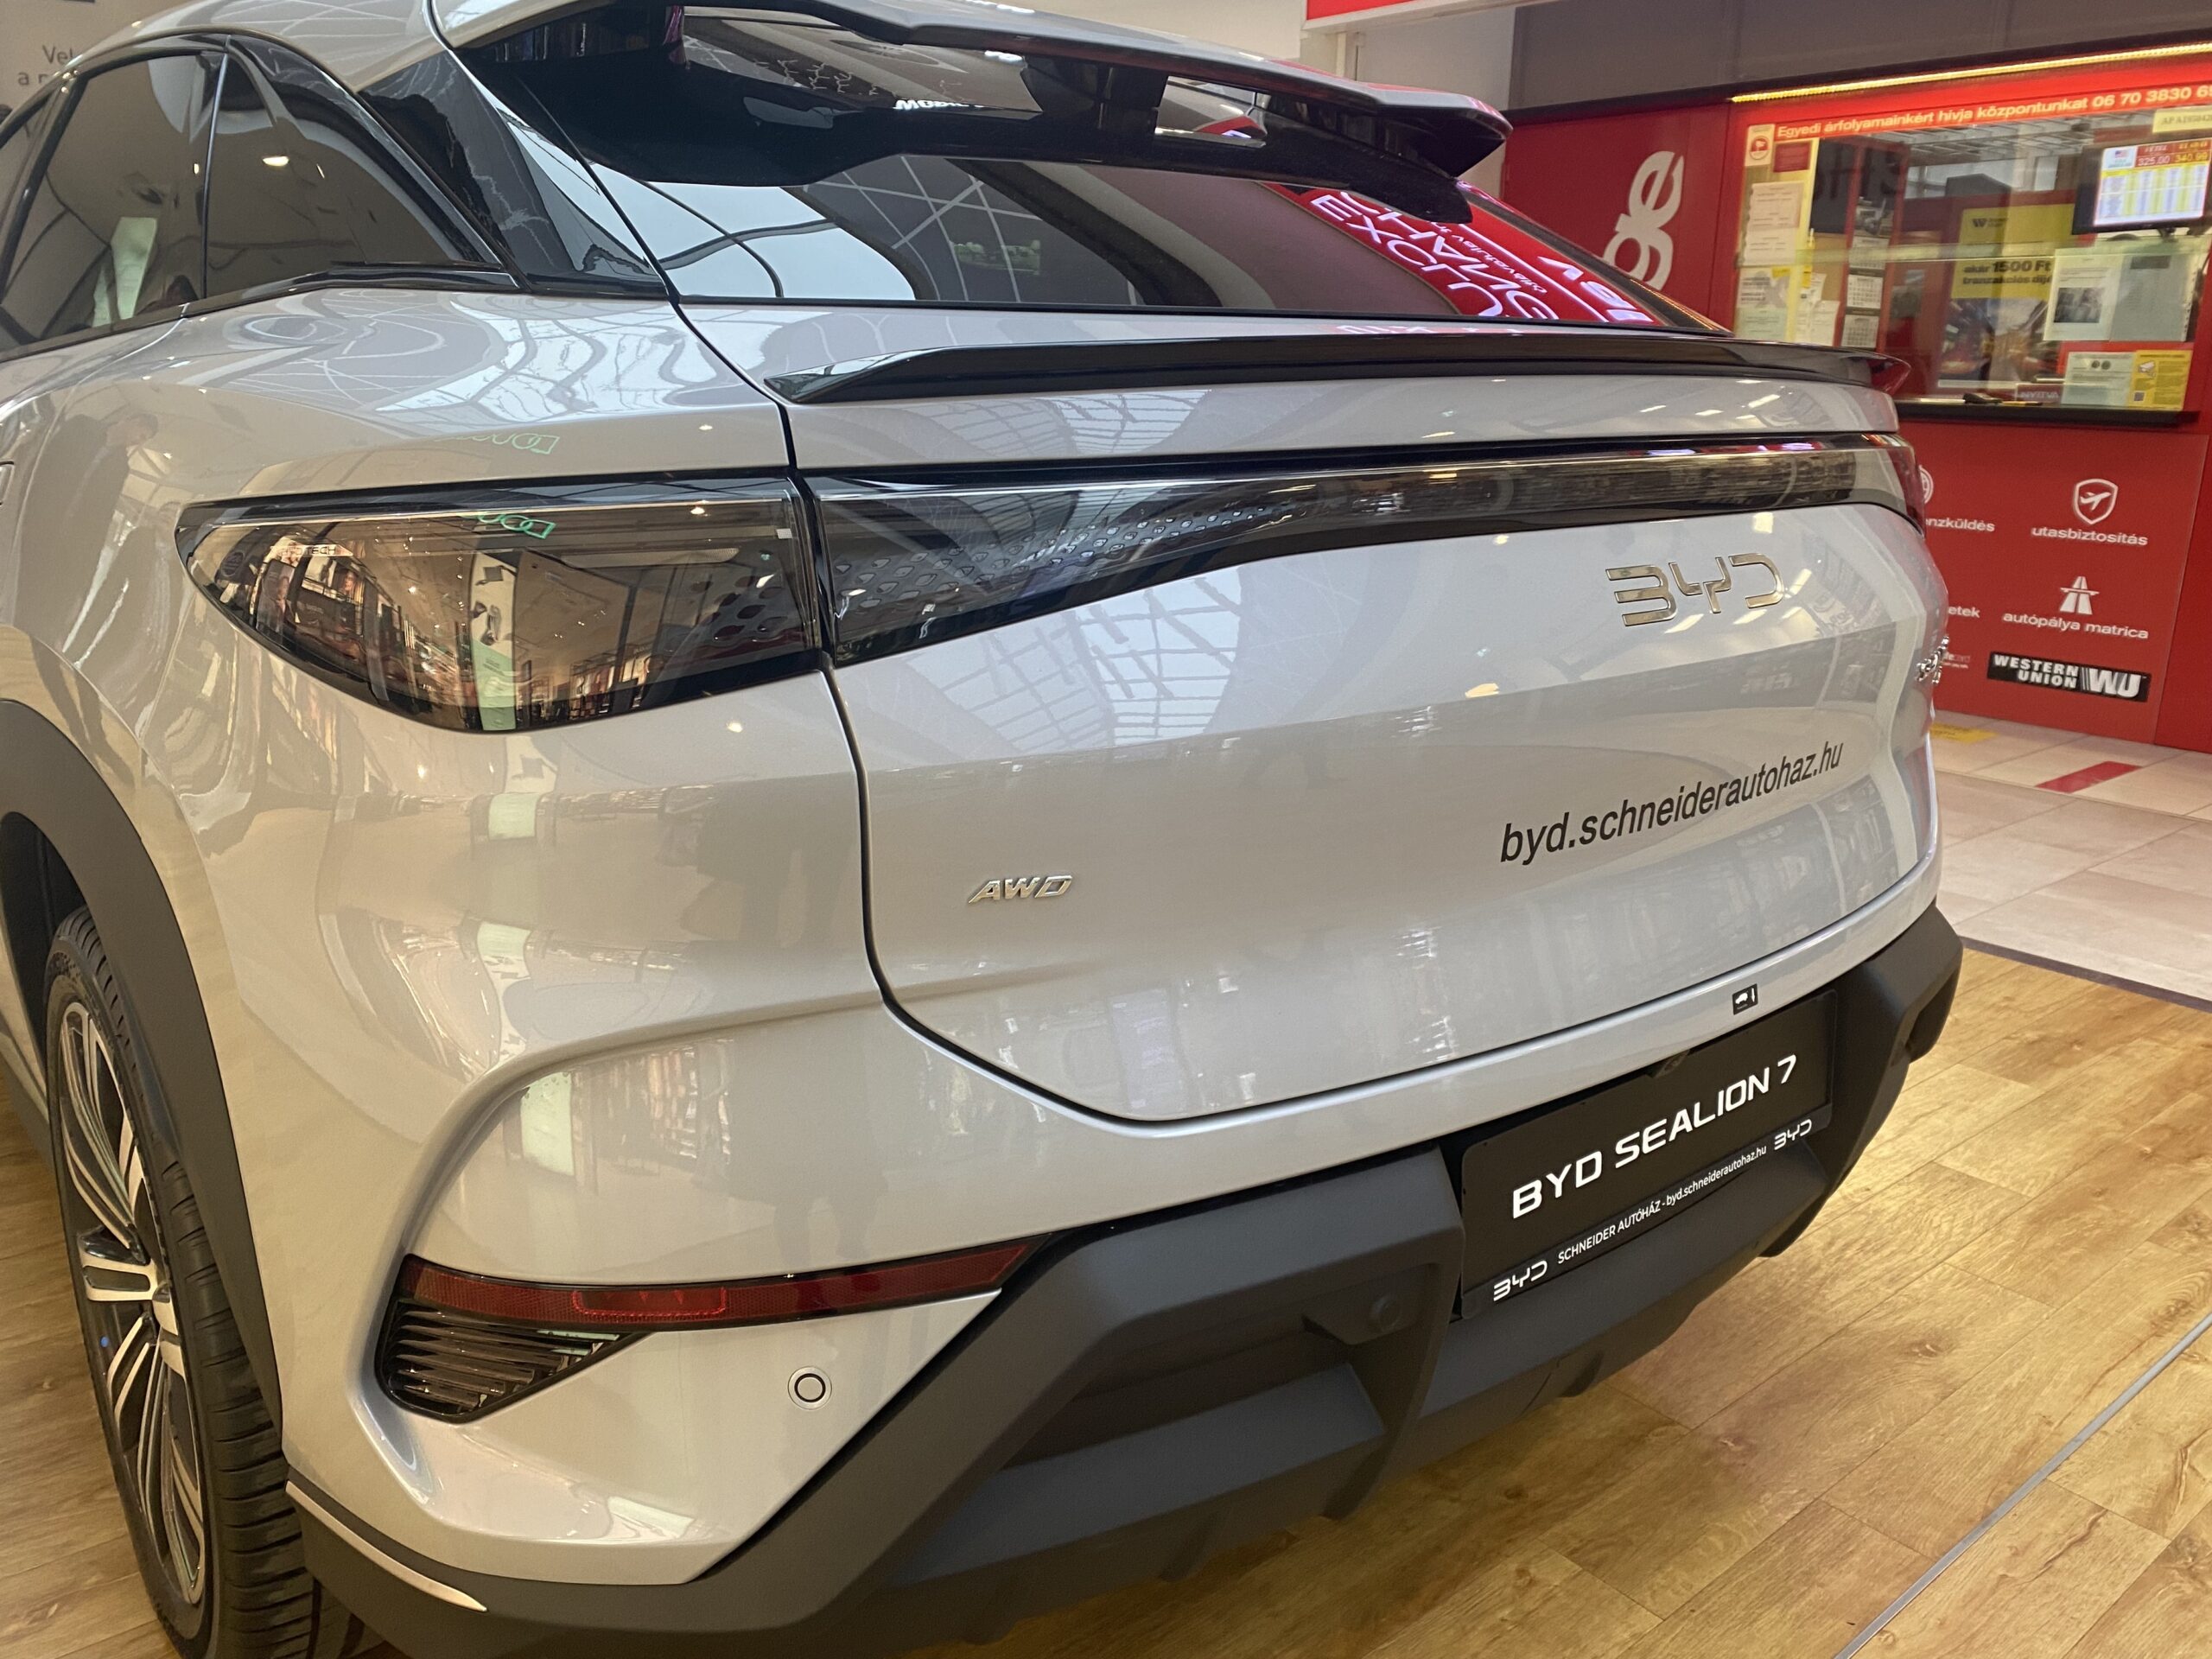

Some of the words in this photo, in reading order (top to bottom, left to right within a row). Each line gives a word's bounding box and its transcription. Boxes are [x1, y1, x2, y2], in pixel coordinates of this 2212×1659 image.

[1777, 123, 1821, 138] Egyedi
[1938, 108, 1973, 122] hívja
[1977, 98, 2088, 118] központunkat
[2092, 94, 2115, 106] 06
[2120, 92, 2141, 105] 70
[2145, 86, 2192, 103] 3830
[1603, 150, 1684, 290] ge
[1993, 260, 2032, 272] 1500
[2035, 260, 2051, 271] Ft
[2031, 526, 2149, 546] utasbiztosítás
[1605, 553, 1784, 626] BYD
[1948, 606, 1980, 618] etek
[2002, 612, 2081, 632] autópálya
[2085, 623, 2149, 639] matrica
[1993, 654, 2079, 677] WESTERN
[2018, 670, 2077, 689] UNION
[1500, 741, 1844, 865] byd.schneiderautohaz.hu
[969, 874, 1072, 904] AWD
[1512, 1150, 1603, 1219] BYD
[1615, 1066, 1770, 1169] SEALION
[1777, 1053, 1797, 1084] 7
[1493, 1260, 1548, 1302] BYD
[1557, 1224, 1617, 1264] SCHNEIDER
[1617, 1199, 1662, 1234] AUTÓHÁZ
[1666, 1145, 1767, 1207] byd.schneiderautohaz.hu
[1774, 1118, 1813, 1151] BYD
